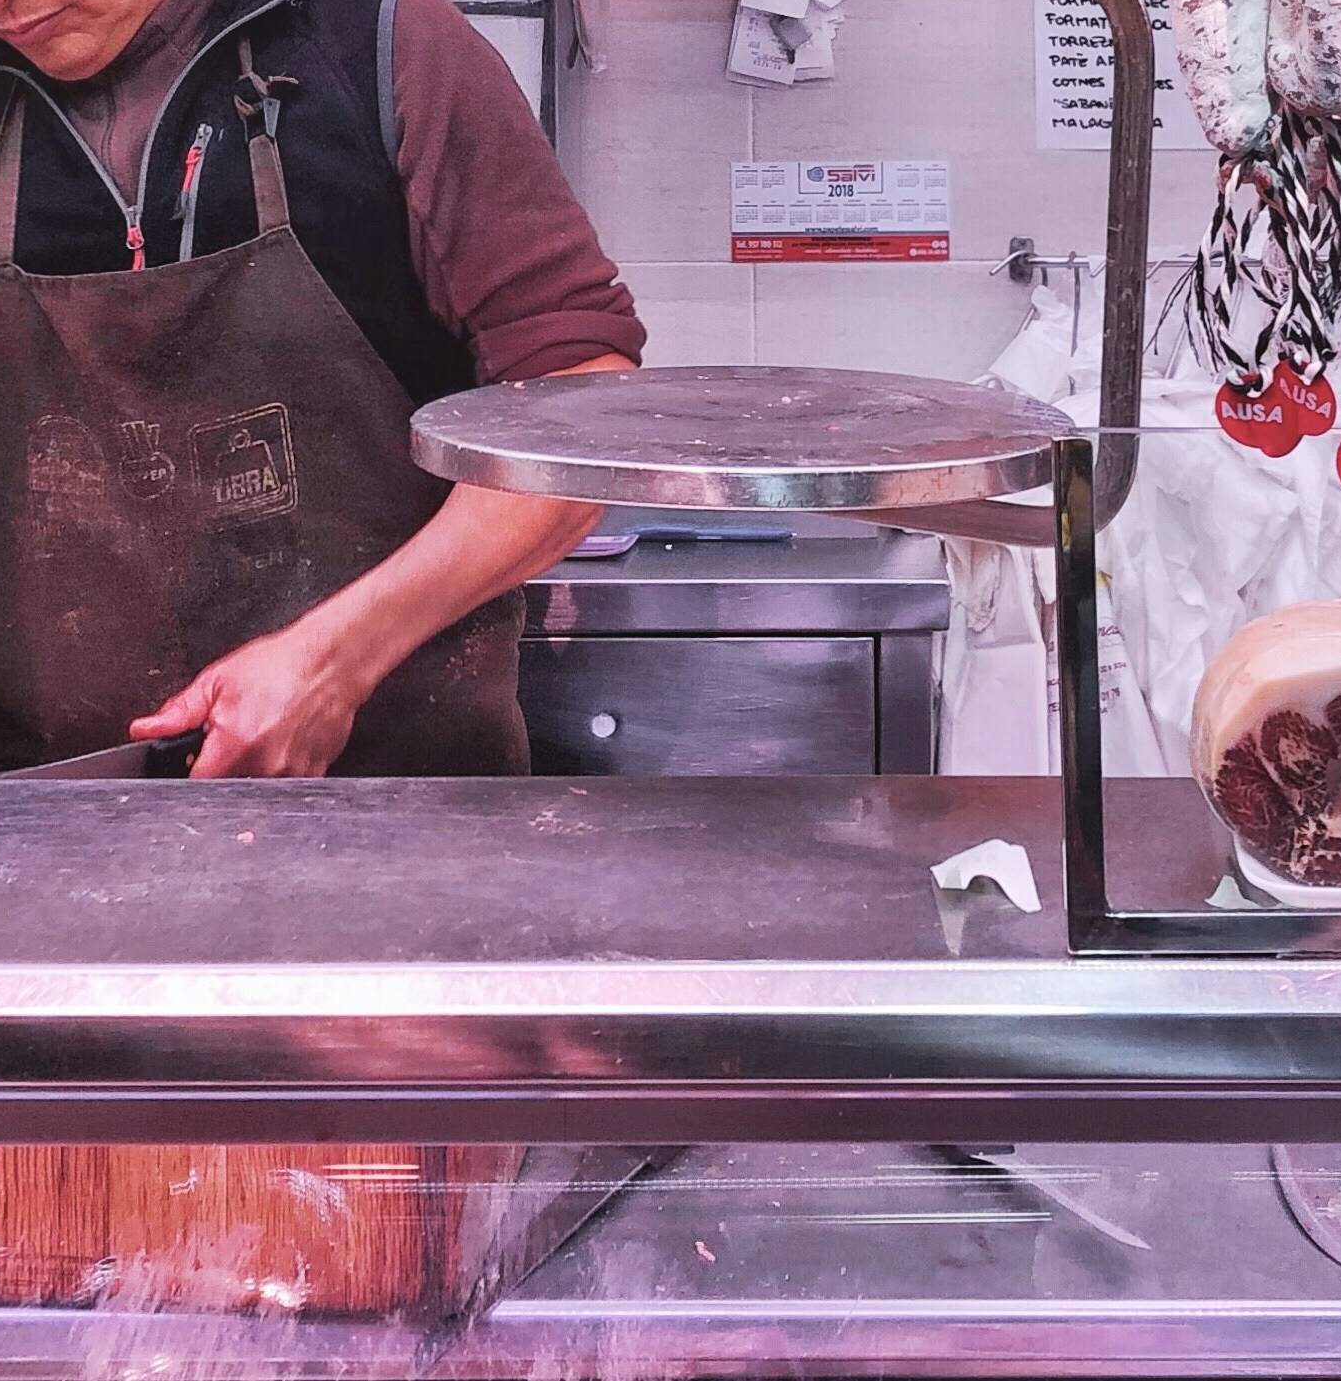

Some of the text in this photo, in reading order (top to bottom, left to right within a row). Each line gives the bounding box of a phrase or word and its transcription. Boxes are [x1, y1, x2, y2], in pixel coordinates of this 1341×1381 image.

[1045, 12, 1109, 30] FORMAT
[827, 184, 855, 198] 2018
[1278, 375, 1332, 421] AUSA
[1220, 399, 1284, 425] AUSA
